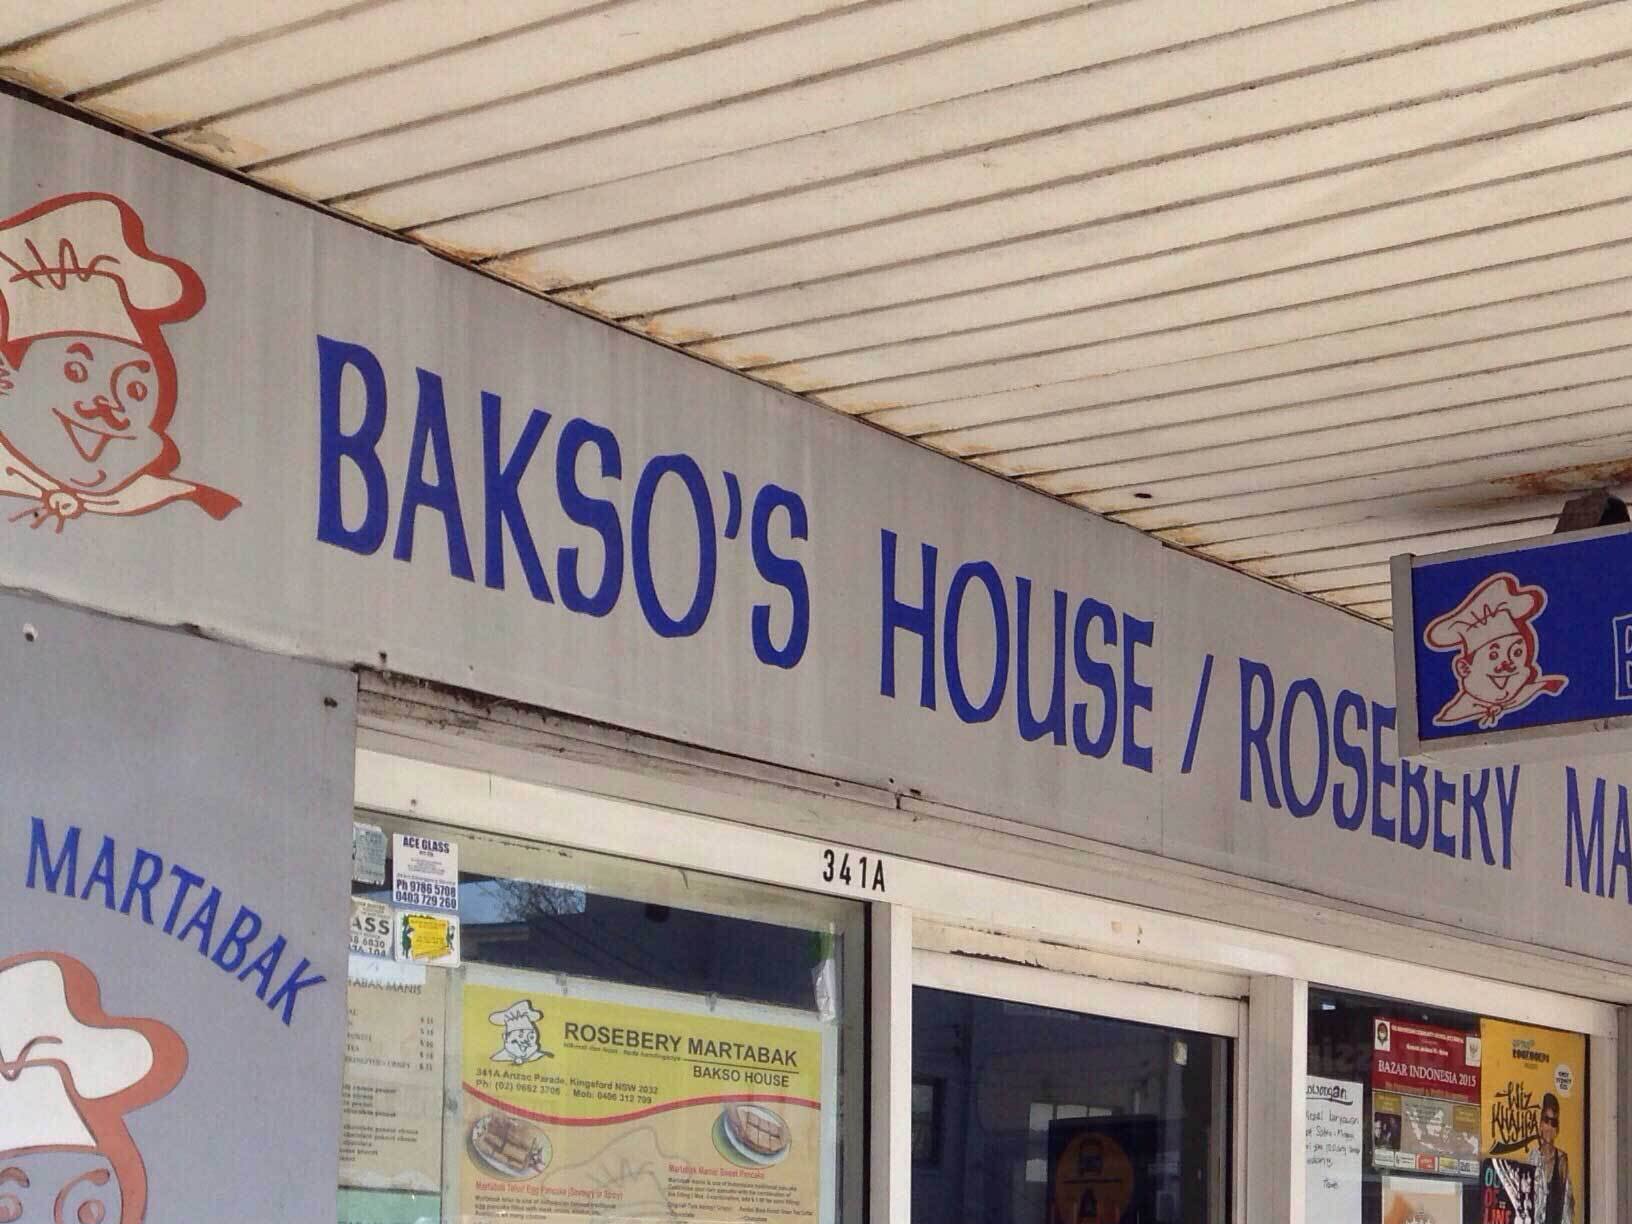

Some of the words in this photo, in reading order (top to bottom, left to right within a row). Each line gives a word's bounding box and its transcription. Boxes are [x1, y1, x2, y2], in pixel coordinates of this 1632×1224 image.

[317, 335, 811, 671] BAKSO'S
[880, 528, 1153, 773] HOUSE
[1181, 653, 1212, 774] /
[1238, 658, 1521, 871] ROSEBERY
[403, 836, 420, 850] ACE
[422, 840, 450, 853] GLASS
[823, 849, 885, 892] 341A
[25, 816, 327, 1027] MARTABAK
[352, 917, 390, 935] ASS
[563, 1022, 682, 1051] ROSEBERY
[688, 1038, 797, 1067] MARTABAK
[693, 1066, 740, 1082] BAKSO
[744, 1070, 789, 1088] HOUSE
[1409, 1065, 1457, 1084] INDONESIA
[1459, 1073, 1477, 1087] 2015
